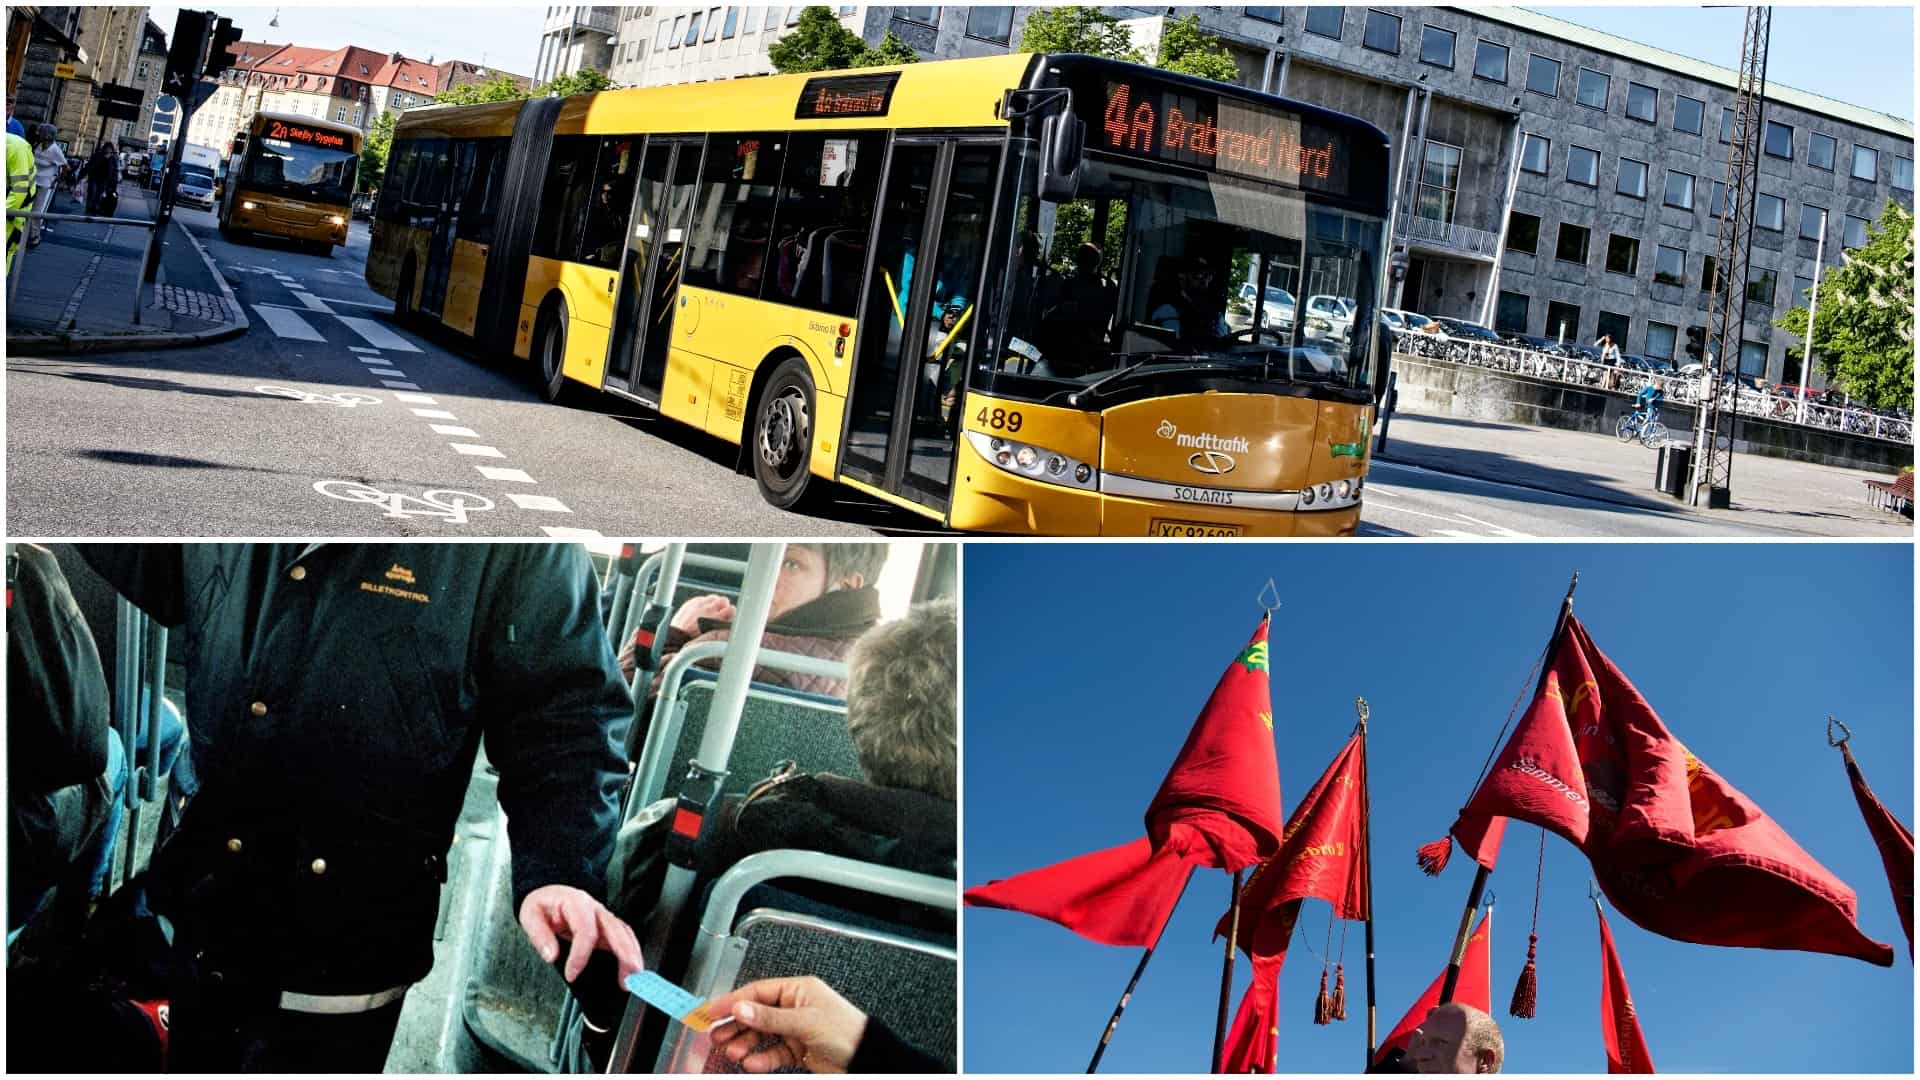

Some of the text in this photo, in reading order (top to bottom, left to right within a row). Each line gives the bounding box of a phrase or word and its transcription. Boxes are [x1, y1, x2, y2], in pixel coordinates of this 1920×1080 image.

[270, 121, 288, 139] 2A
[1103, 83, 1332, 179] 4A Brabrand Nord
[976, 406, 1023, 433] 489
[1176, 431, 1249, 453] midttrafik
[1173, 487, 1233, 505] SOLARIS
[360, 582, 430, 603] BILLETKONTROL
